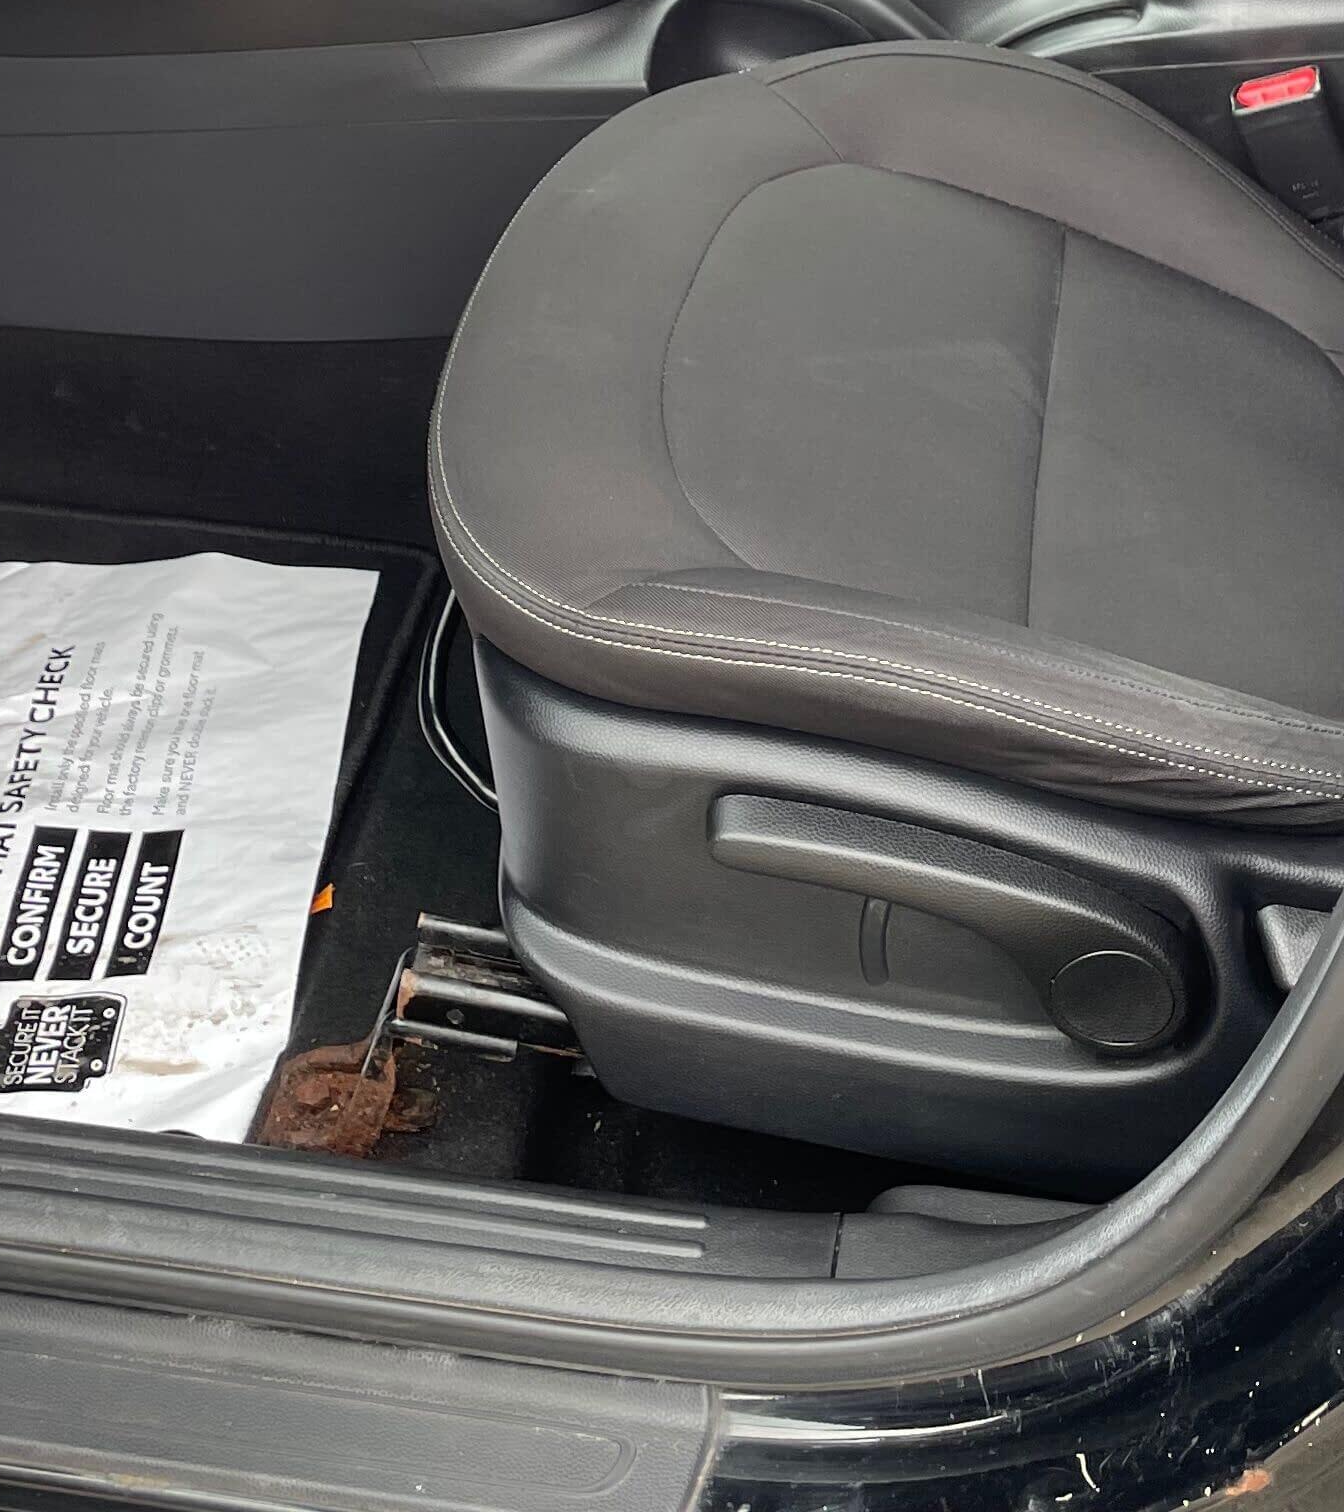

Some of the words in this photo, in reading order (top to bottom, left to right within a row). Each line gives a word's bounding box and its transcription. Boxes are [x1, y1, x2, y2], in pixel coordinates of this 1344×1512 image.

[28, 645, 74, 721] CHECK
[162, 757, 175, 782] sure
[168, 736, 180, 755] you
[178, 750, 197, 790] NEVER
[122, 755, 145, 796] factory
[175, 794, 189, 815] and
[4, 842, 66, 965] CONFIRM
[64, 855, 118, 954] SECURE
[121, 861, 171, 947] COUNT
[69, 1004, 94, 1021] IT
[2, 1021, 36, 1085] SECURE
[19, 1006, 41, 1020] IT
[26, 1004, 72, 1083] NEVER
[54, 1025, 89, 1082] STACK
